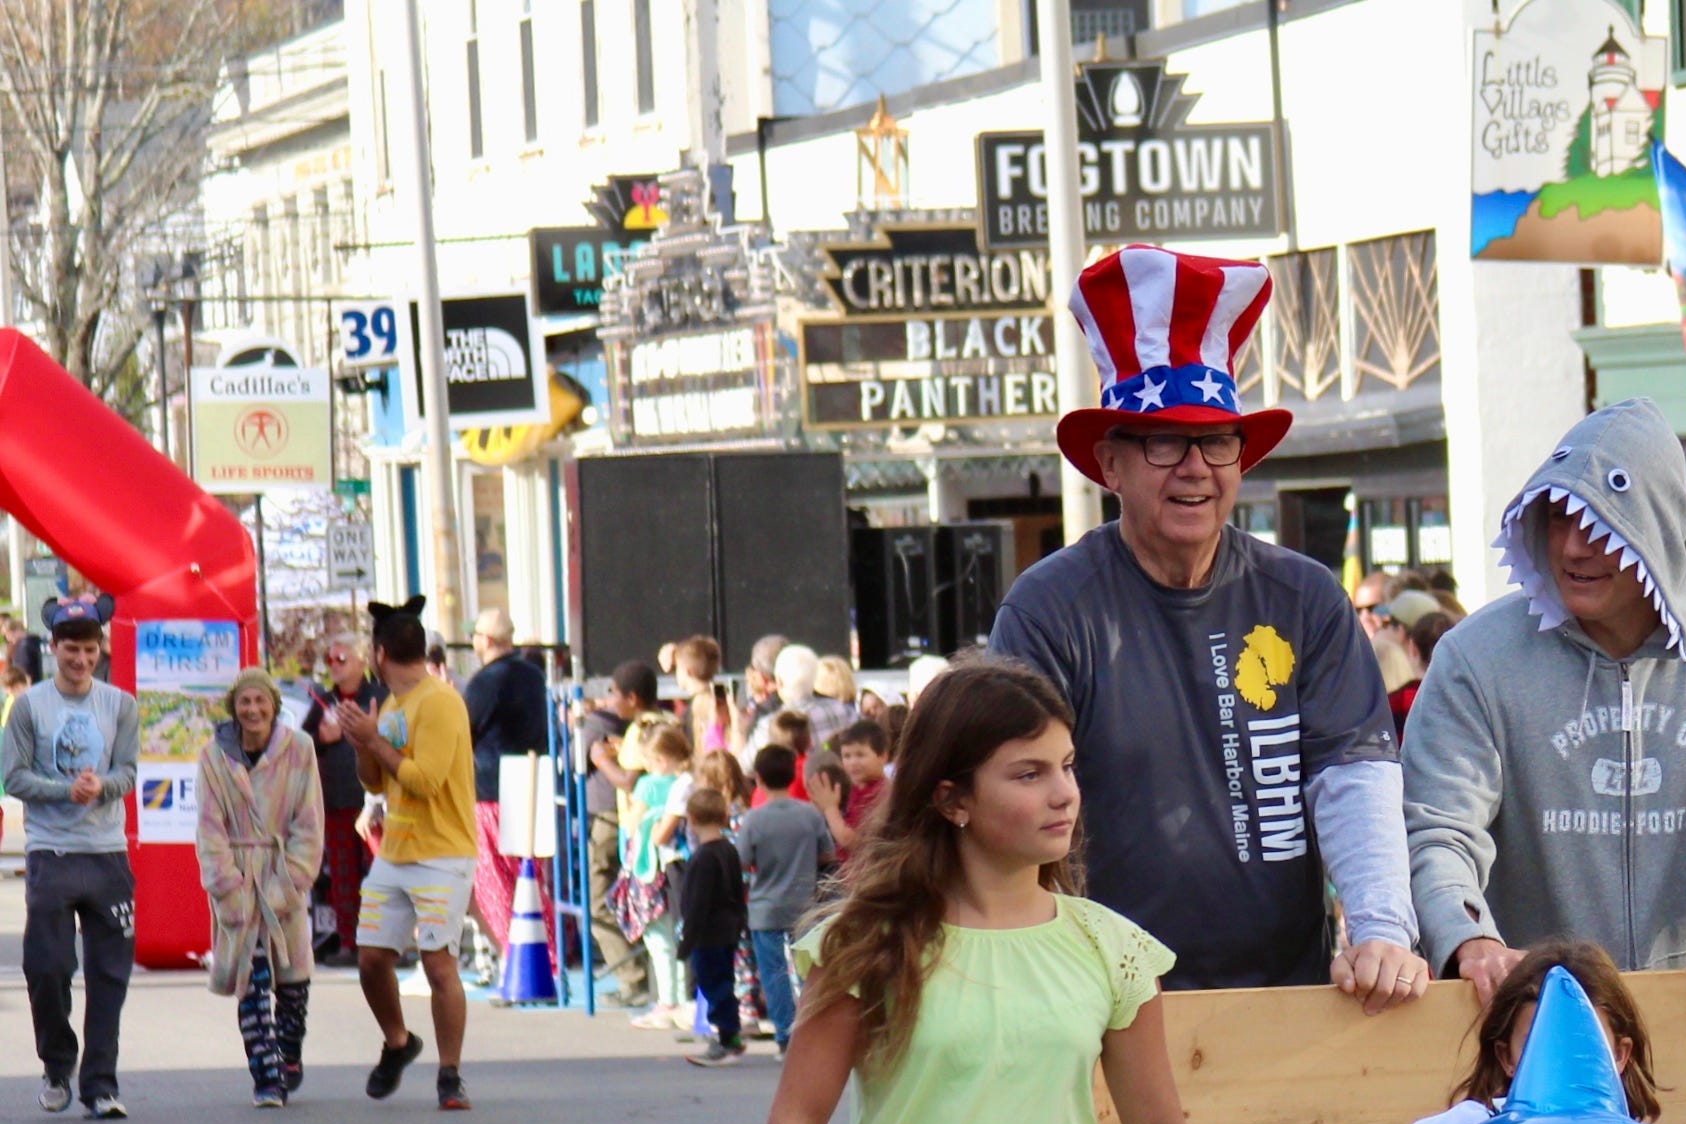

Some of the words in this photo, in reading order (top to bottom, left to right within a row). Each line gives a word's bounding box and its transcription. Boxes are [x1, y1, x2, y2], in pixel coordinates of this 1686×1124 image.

[1481, 50, 1558, 88] Little
[1479, 86, 1572, 132] Village
[1481, 120, 1550, 159] Gifts
[995, 137, 1264, 199] FOGTOWN
[999, 200, 1121, 236] BRENG
[1135, 196, 1265, 231] COMPANY
[841, 250, 1047, 310] CRITERION
[341, 307, 398, 359] 39
[446, 328, 486, 349] THE
[905, 315, 1046, 361] BLACK
[209, 375, 311, 395] Cadillac's
[446, 363, 489, 384] ACE
[859, 371, 1057, 421] PANTHER
[333, 530, 367, 545] ONE
[333, 548, 368, 563] WAY
[145, 630, 230, 650] DREAM
[154, 655, 223, 674] FIRST
[1210, 643, 1230, 689] Love
[1217, 693, 1236, 729] Bar
[1221, 733, 1249, 800] Harbor
[1247, 713, 1308, 862] ILBHM
[1231, 804, 1251, 864] Maine
